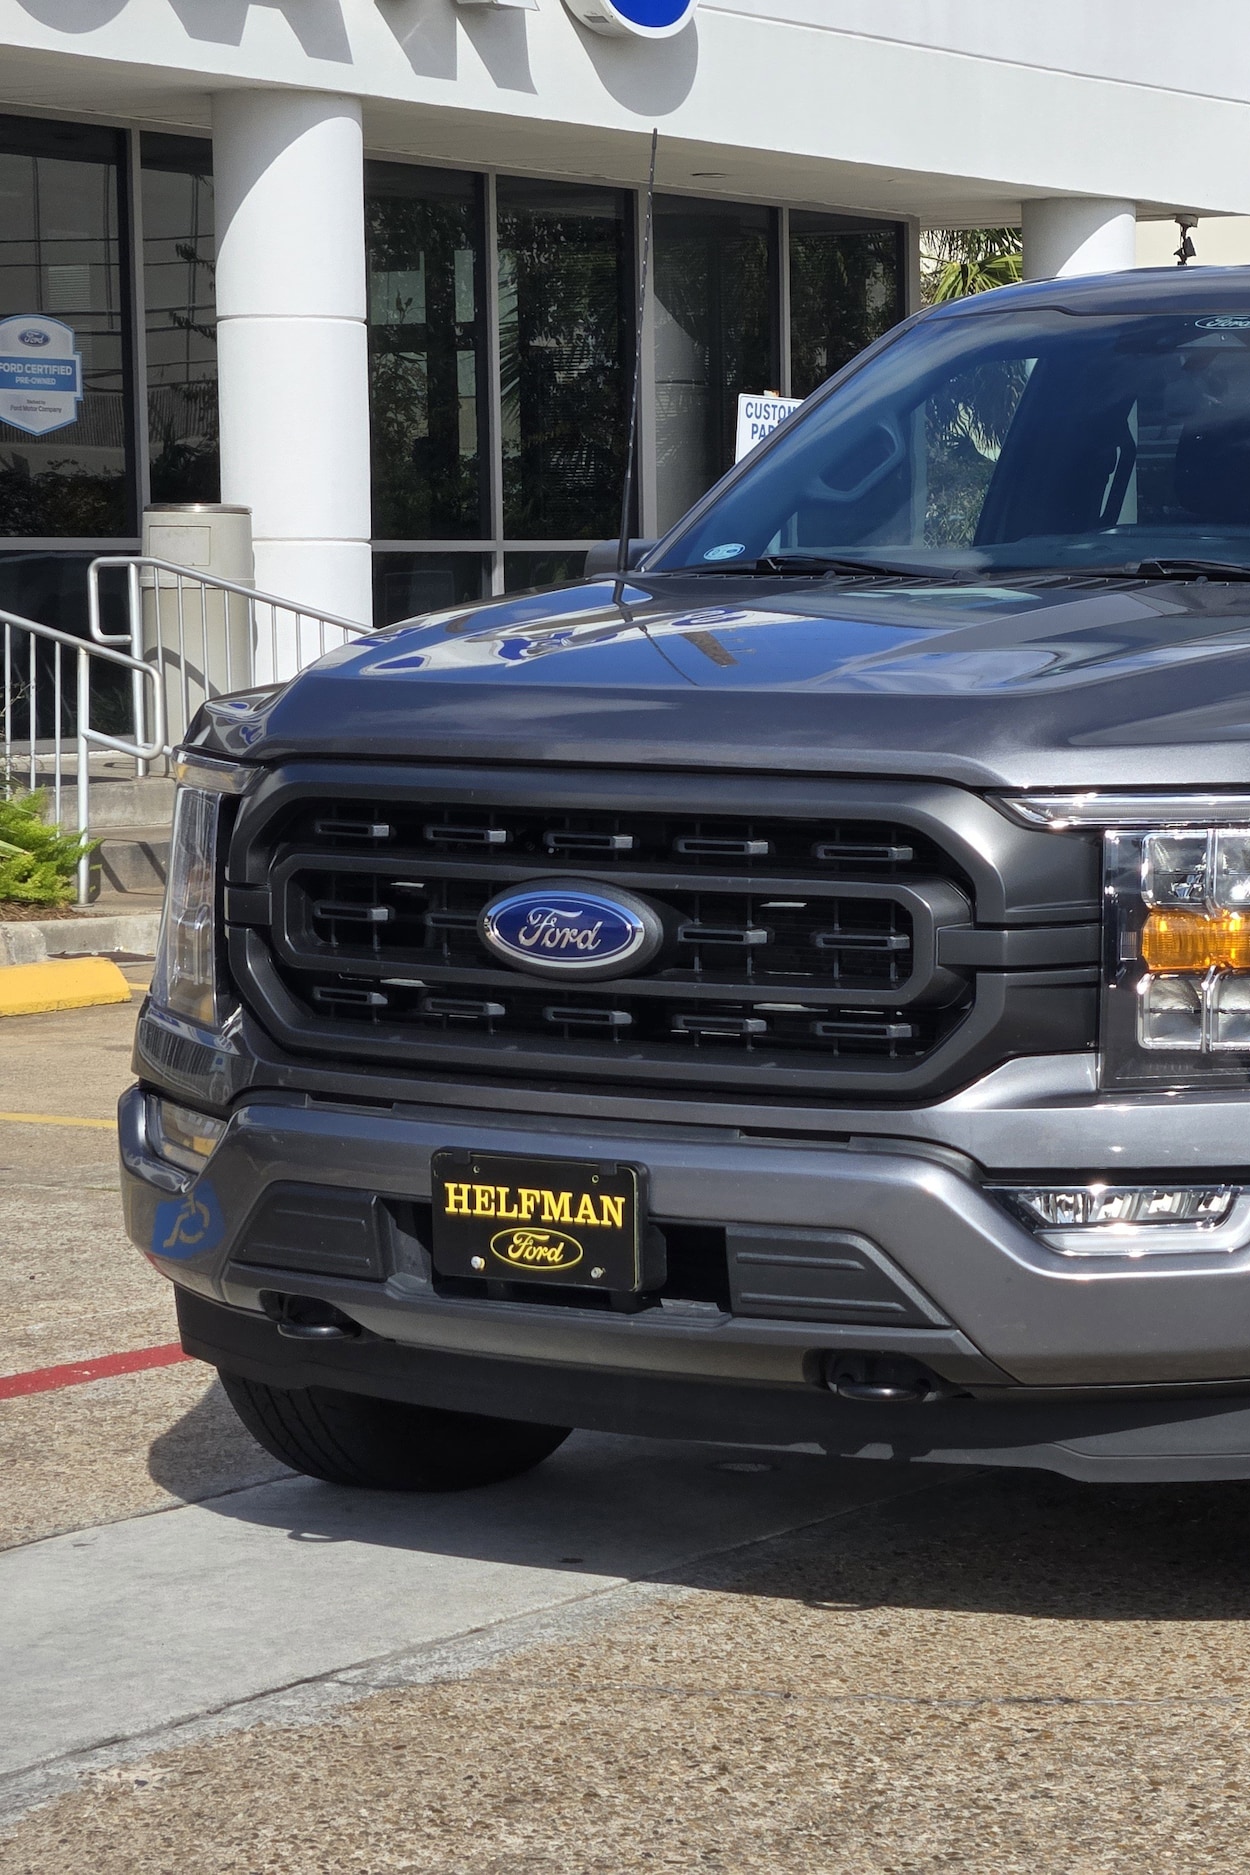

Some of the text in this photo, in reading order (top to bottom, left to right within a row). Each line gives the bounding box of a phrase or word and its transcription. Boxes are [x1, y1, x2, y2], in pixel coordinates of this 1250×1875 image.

[15, 376, 56, 385] PRE-OWNED
[25, 364, 73, 375] CERTIFIED
[518, 906, 603, 951] Ford
[444, 1182, 626, 1228] HELFMAN
[508, 1231, 565, 1262] Ford
